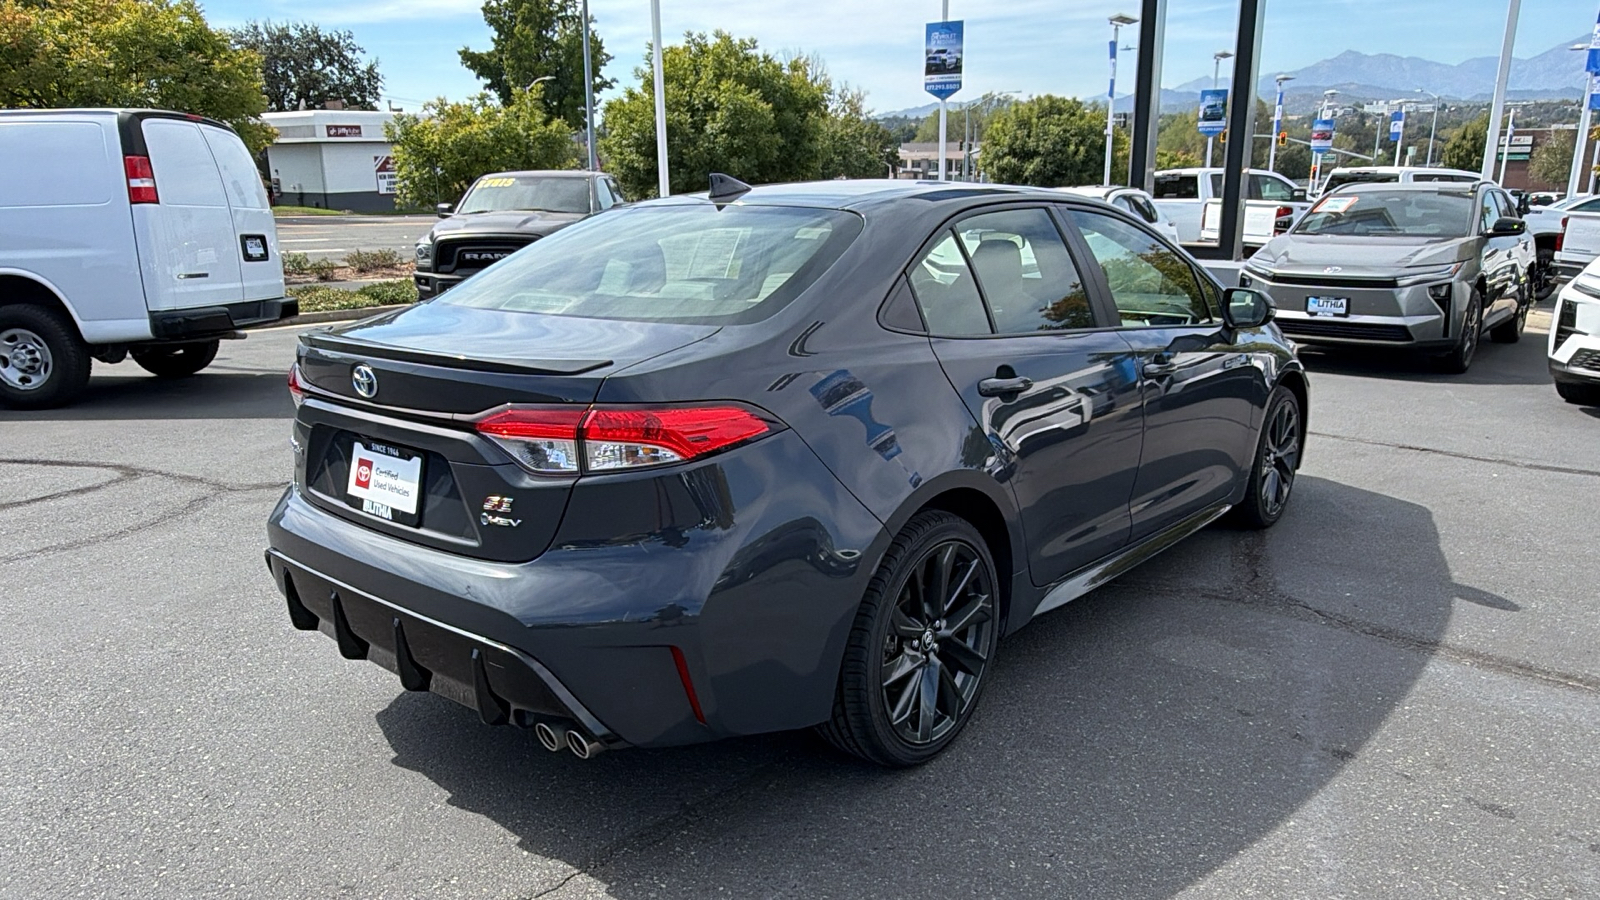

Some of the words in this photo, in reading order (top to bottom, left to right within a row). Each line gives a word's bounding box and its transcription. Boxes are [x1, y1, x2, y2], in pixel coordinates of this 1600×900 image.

[1317, 299, 1345, 309] LITHIA
[371, 442, 386, 454] SINCE
[386, 446, 400, 457] 1946
[375, 466, 399, 481] Certified
[373, 478, 388, 491] Used
[388, 482, 410, 498] Vehicles
